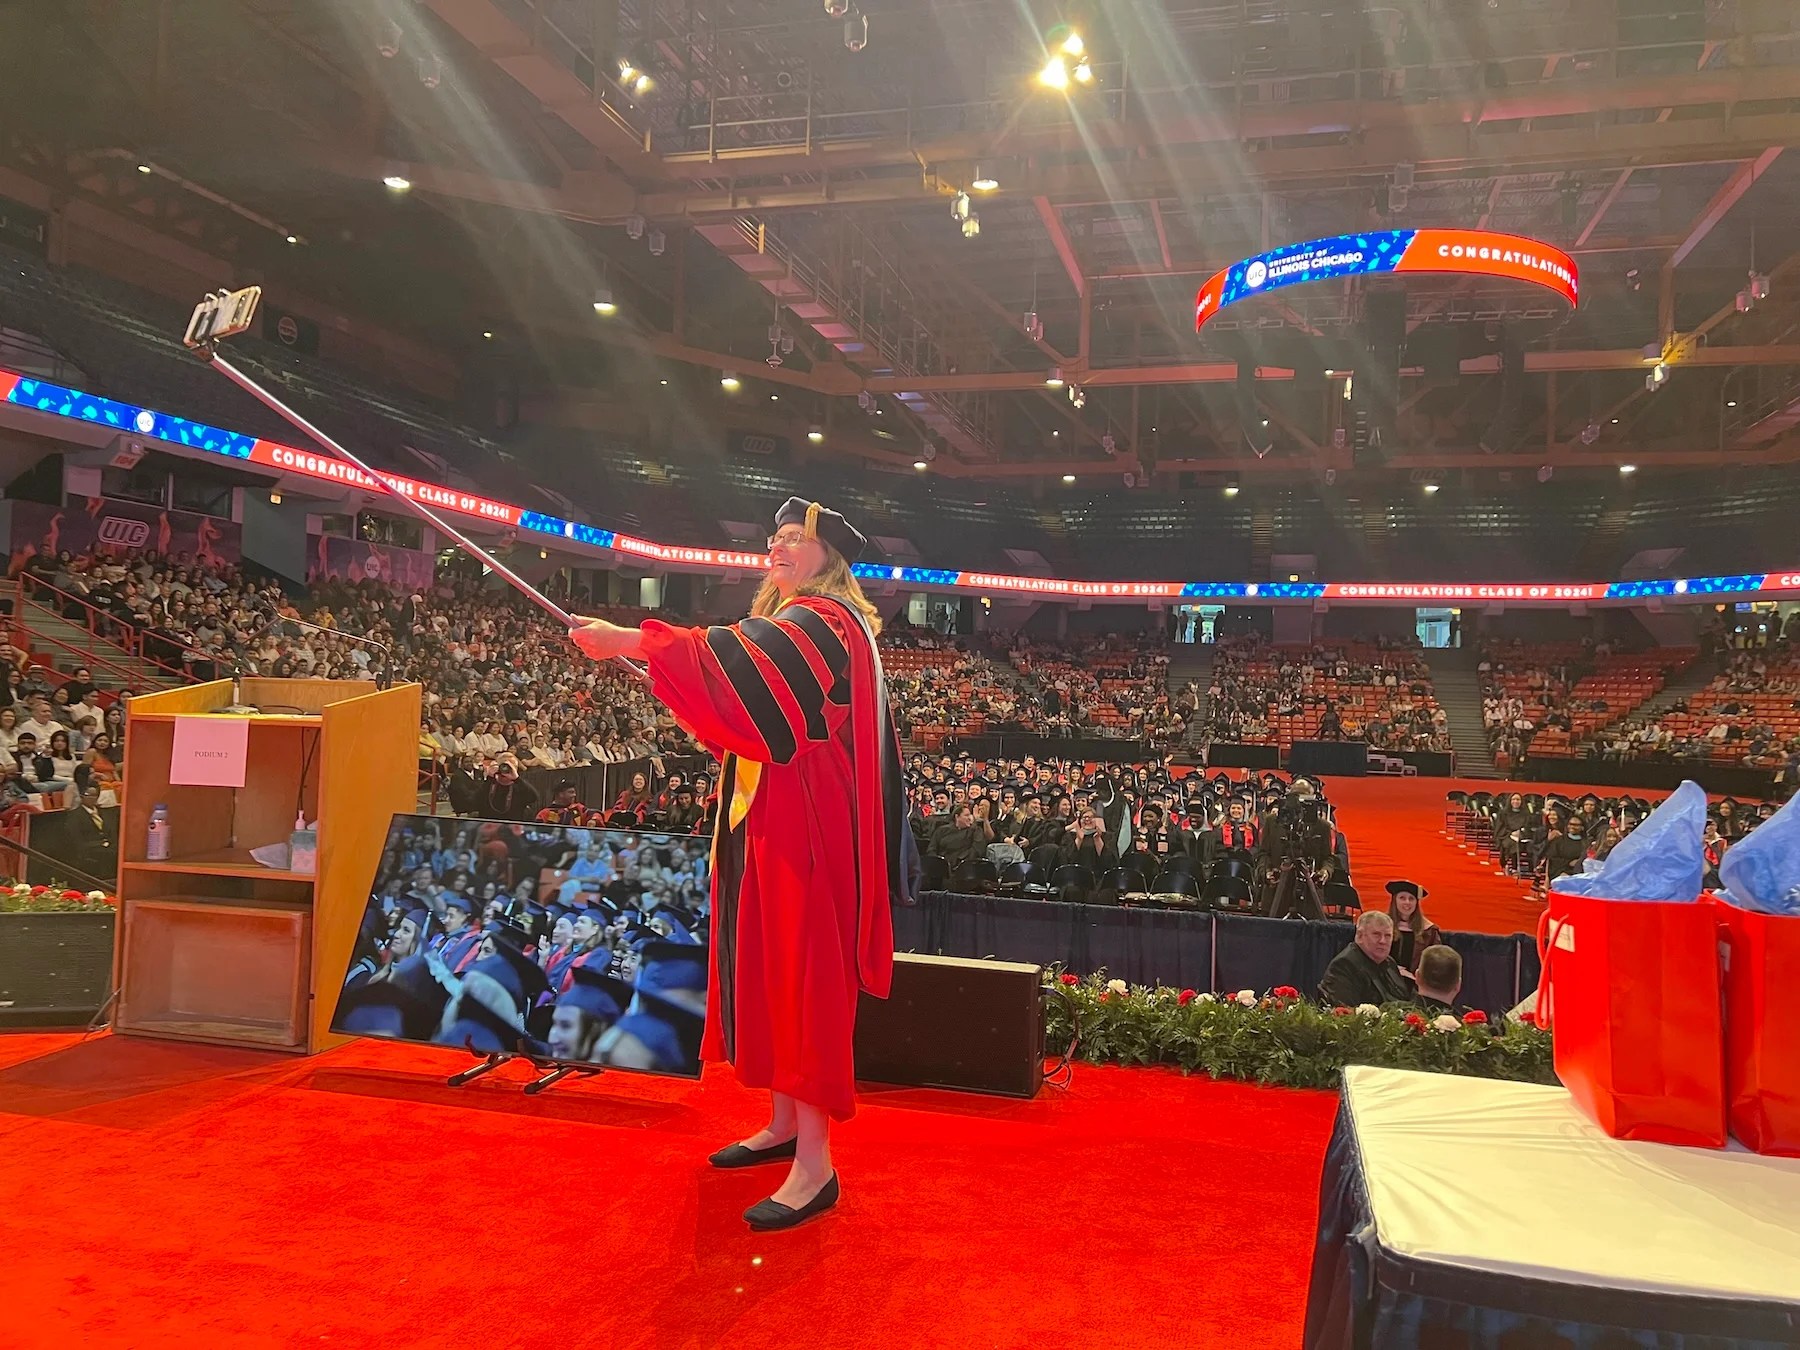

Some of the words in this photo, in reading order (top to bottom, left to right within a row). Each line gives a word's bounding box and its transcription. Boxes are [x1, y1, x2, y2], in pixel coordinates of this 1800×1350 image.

[1268, 250, 1316, 269] UNIVERSITY
[1316, 247, 1329, 258] OF
[1268, 257, 1310, 279] ILLINOIS
[1311, 251, 1364, 270] CHICAGO
[1438, 244, 1571, 285] CONGRATULATIONS
[418, 486, 457, 507] CLASS
[460, 495, 477, 511] OF
[480, 500, 509, 520] 2024!
[100, 518, 149, 545] UIC
[717, 553, 759, 566] CLASS
[969, 575, 1069, 592] CONGRATULATIONS
[1072, 583, 1107, 594] CLASS
[1112, 585, 1129, 594] OF
[1133, 585, 1169, 594] 2024!
[1339, 586, 1473, 597] CONGRATULATIONS
[1478, 587, 1523, 597] CLASS
[1529, 587, 1549, 597] OF
[1554, 587, 1593, 597] 2024!
